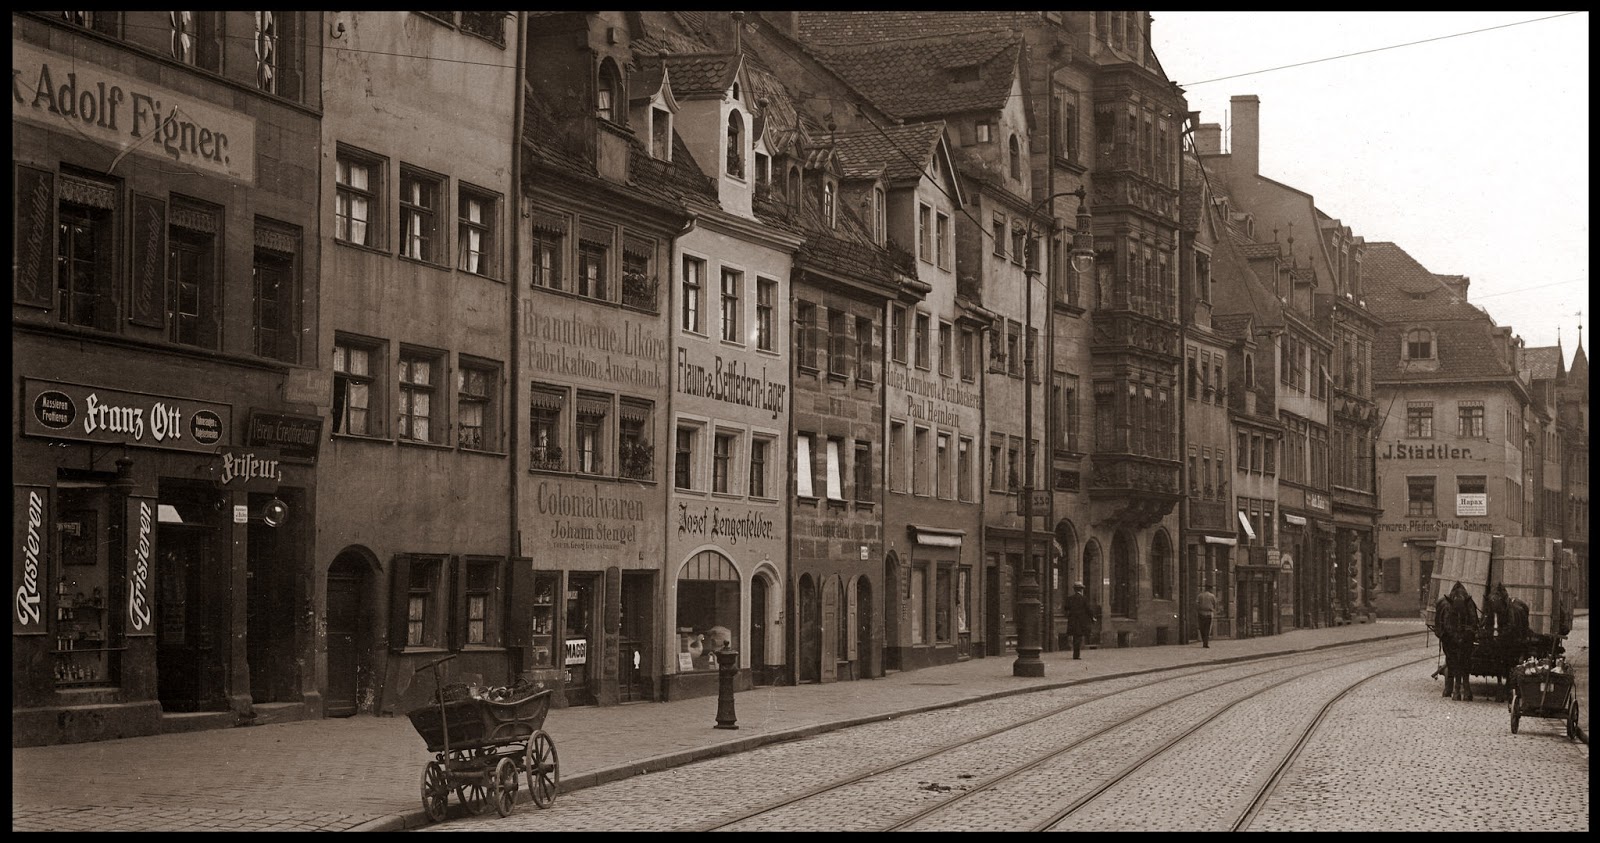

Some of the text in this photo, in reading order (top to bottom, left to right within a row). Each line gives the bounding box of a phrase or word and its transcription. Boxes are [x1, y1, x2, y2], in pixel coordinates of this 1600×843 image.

[31, 63, 124, 131] Adolf
[130, 91, 230, 164] Figner.
[528, 340, 597, 378] Fabrikation
[83, 392, 182, 442] Franz Ott
[906, 395, 925, 421] Paul
[537, 481, 644, 522] Colonialwaren
[677, 501, 708, 542] Josef
[551, 520, 636, 545] Johann Stengel
[1377, 523, 1409, 533] erwaren,
[15, 490, 43, 626] Rasieren
[129, 500, 152, 631] Frisieren
[565, 643, 586, 659] MAGGI
